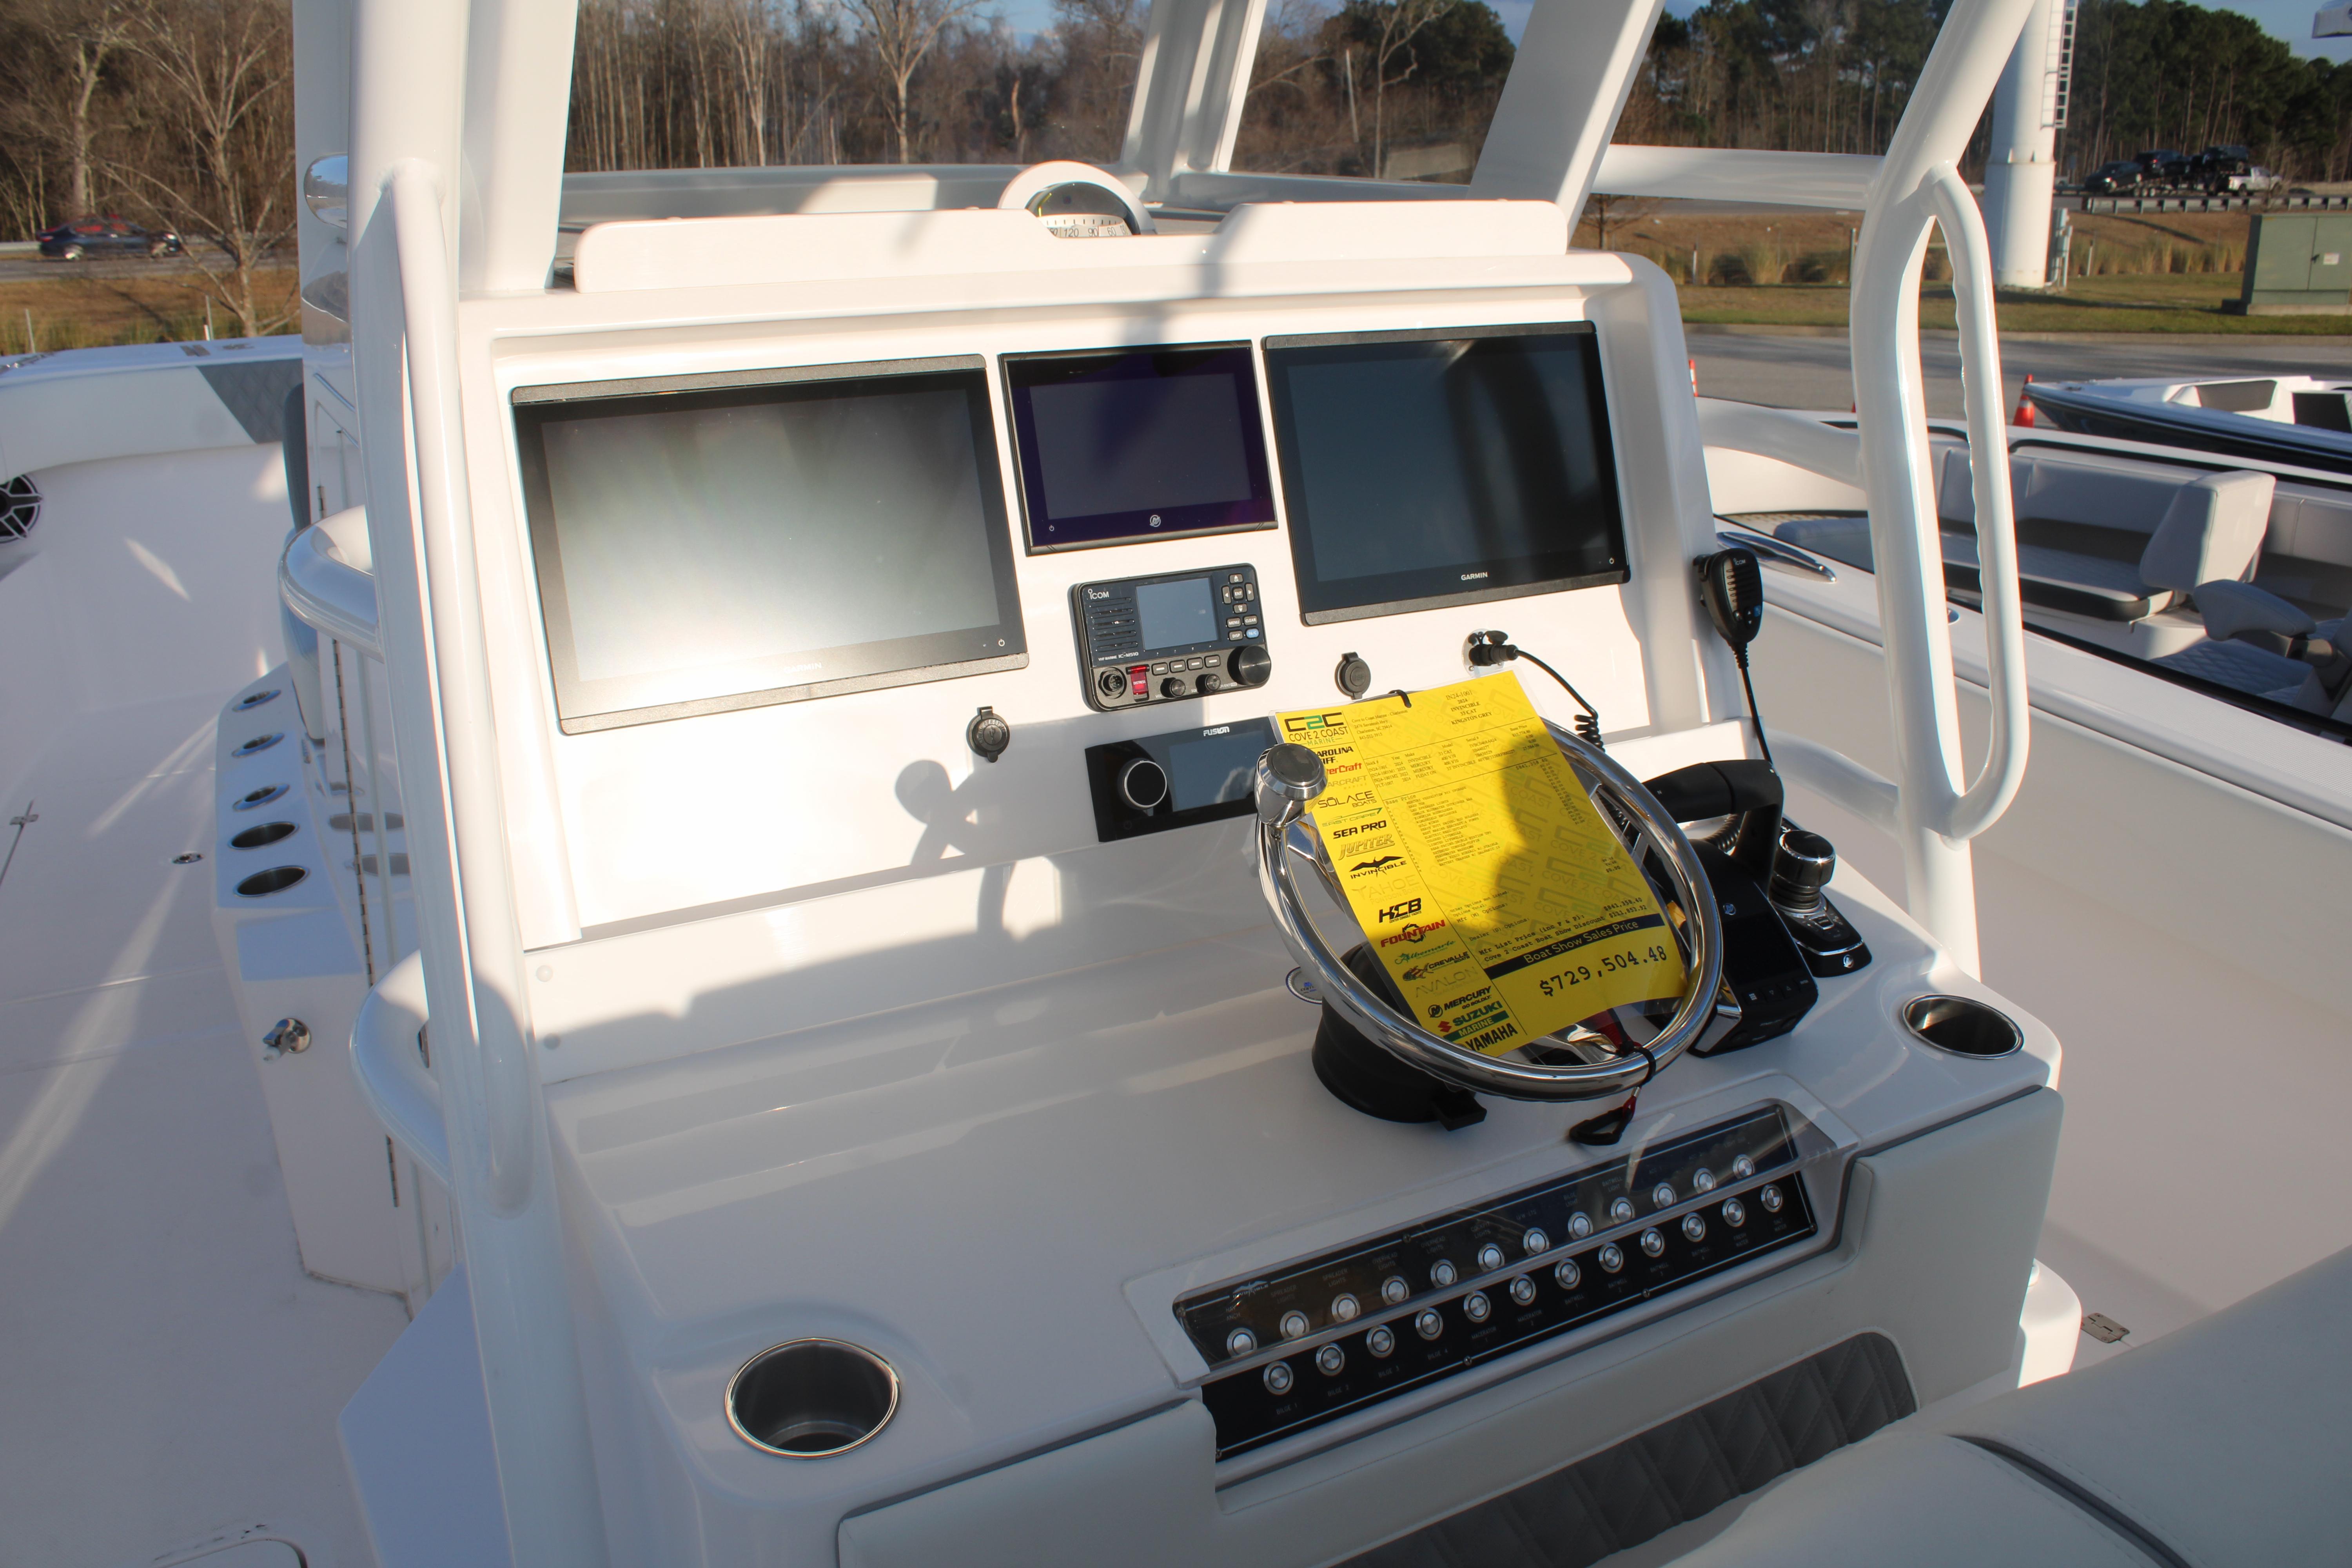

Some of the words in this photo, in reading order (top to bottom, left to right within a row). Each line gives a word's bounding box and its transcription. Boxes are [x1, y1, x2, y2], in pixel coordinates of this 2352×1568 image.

[1064, 229, 1079, 237] 120
[1107, 227, 1116, 236] 60
[1461, 572, 1488, 581] GARMIN
[784, 662, 822, 673] GARMIN
[1445, 690, 1472, 700] IN24-1001
[1450, 701, 1480, 711] INVINCIBLE
[1451, 715, 1477, 724] KINGSTON
[1203, 726, 1230, 737] FUSION
[1289, 731, 1313, 742] COVE
[1314, 730, 1321, 739] 2
[1321, 726, 1349, 738] COAST
[1307, 738, 1335, 746] MARINE
[1315, 746, 1354, 757] AROLINA
[1408, 755, 1431, 763] INVINCIBLE
[1452, 760, 1476, 769] INVINCIBLE
[1327, 775, 1368, 788] ARCRAFT
[1352, 799, 1377, 808] BOATS
[1350, 812, 1377, 821] CAPE
[1333, 827, 1358, 839] SEA
[1361, 820, 1387, 833] PRO
[1338, 833, 1395, 860] JUPITER
[1350, 860, 1407, 879] INVINCIBLE
[1352, 874, 1419, 900] TAHOE
[1465, 900, 1482, 908] Options
[1482, 903, 1508, 914] Options:
[1379, 898, 1421, 923] HCB
[1469, 931, 1490, 942] Dealer
[1504, 918, 1530, 929] Options:
[1478, 947, 1493, 955] Mfr
[1495, 940, 1513, 949] List
[1514, 931, 1536, 942] Price
[1539, 924, 1555, 933] (inc
[1604, 897, 1643, 911] $841,358.40
[1381, 920, 1446, 947] FOUNTAIN
[1484, 953, 1502, 962] Cove
[1512, 941, 1534, 952] Coast
[1535, 934, 1553, 943] Boat
[1555, 927, 1572, 936] Show
[1573, 916, 1606, 929] Discount
[1609, 905, 1648, 918] $111,853.92
[1523, 948, 1552, 963] Boat
[1552, 938, 1583, 953] Show
[1583, 928, 1613, 942] Sales
[1612, 921, 1639, 933] Price
[1429, 951, 1468, 969] CREVALLE
[1539, 945, 1667, 996] $729,504.48
[1444, 986, 1491, 1011] MERCURY
[1452, 1000, 1503, 1027] SUZUKI
[1459, 1017, 1494, 1037] MARINE
[1465, 1023, 1518, 1051] YAMAHA
[1608, 1184, 1620, 1192] LIGHT
[1774, 1222, 1788, 1232] WATER
[1474, 1229, 1491, 1239] LIGHTS
[1421, 1236, 1446, 1249] OVERHEAD
[1735, 1238, 1749, 1248] WATER
[1427, 1245, 1444, 1254] LIGHTS
[1372, 1252, 1398, 1265] OVERHEAD
[1378, 1261, 1396, 1270] LIGHTS
[1322, 1268, 1348, 1281] SPREADER
[1328, 1277, 1346, 1287] LIGHTS
[1270, 1285, 1298, 1298] SPREADER
[1277, 1294, 1296, 1304] LIGHTS
[1427, 1350, 1442, 1361] BILGE
[1378, 1368, 1394, 1379] BILGE
[1327, 1386, 1343, 1397] BILGE
[1276, 1404, 1291, 1415] BILGE
